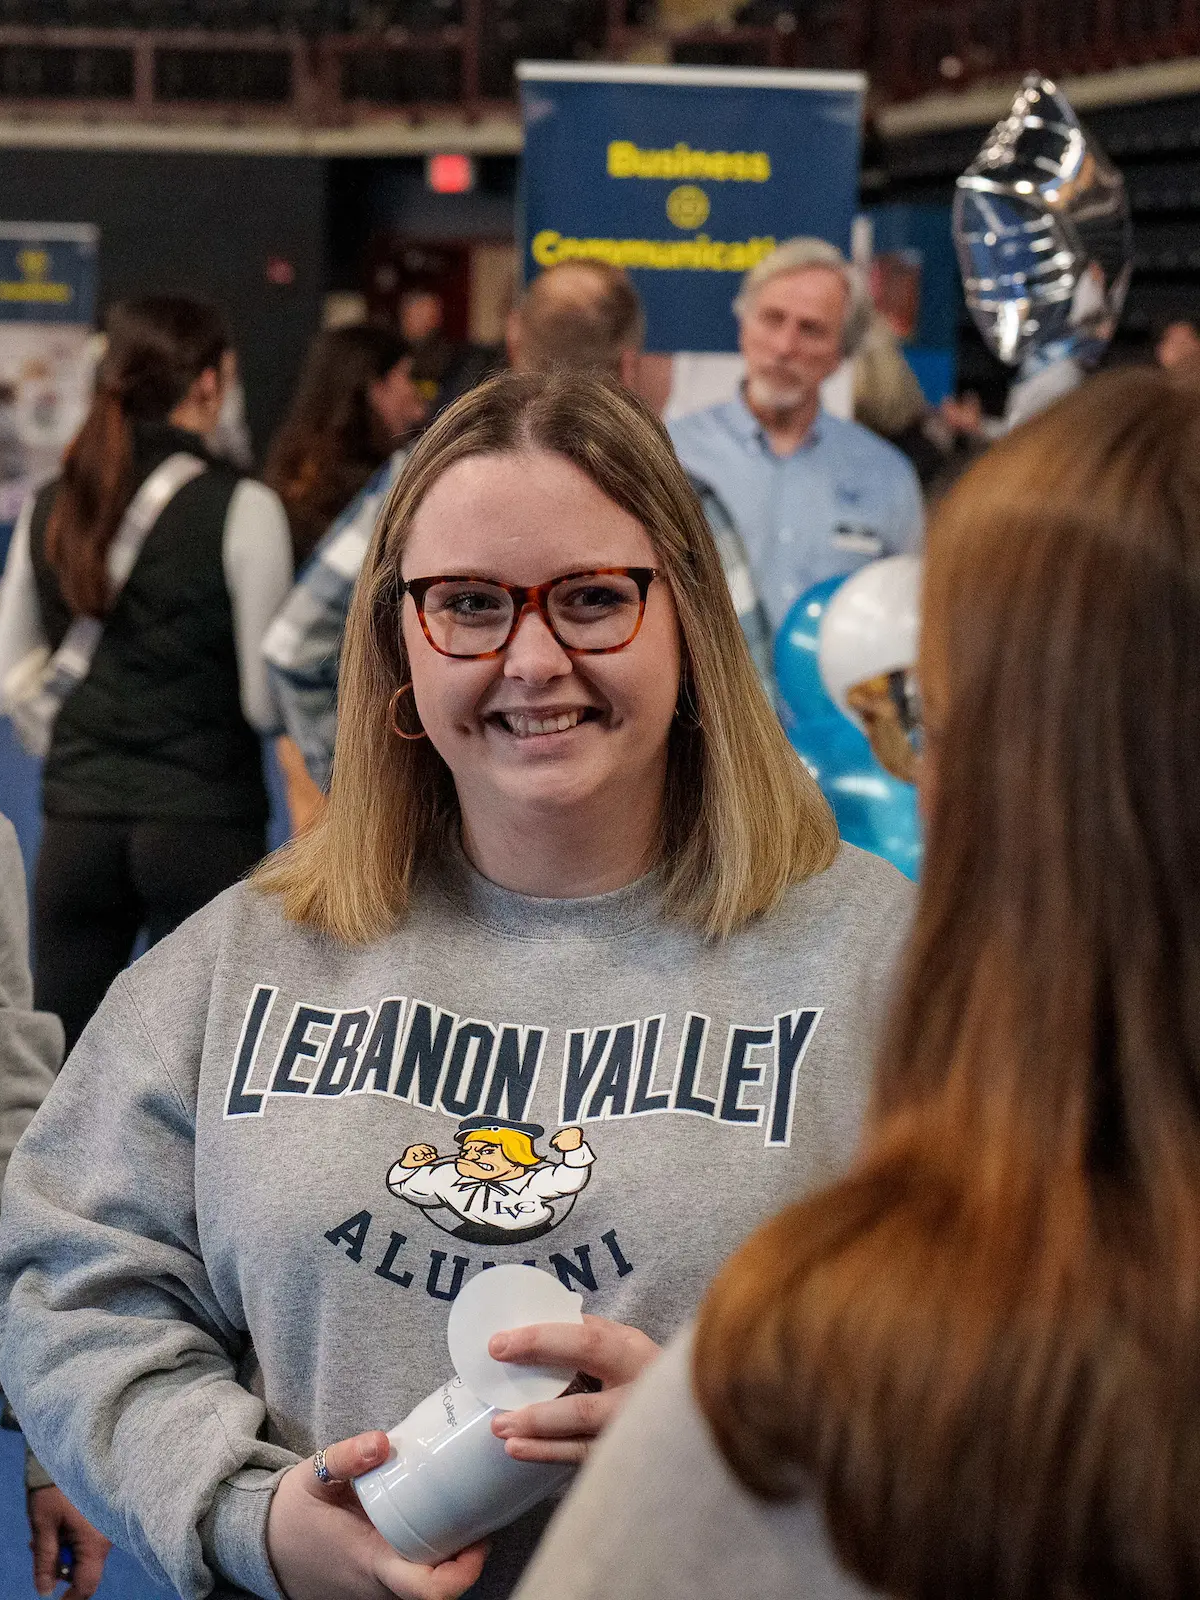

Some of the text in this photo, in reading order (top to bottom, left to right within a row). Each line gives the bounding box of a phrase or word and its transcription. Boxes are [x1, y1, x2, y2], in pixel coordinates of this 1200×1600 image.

[607, 141, 770, 182] Business
[223, 983, 824, 1147] LEBANON VALLEY
[324, 1209, 637, 1302] ALUNI
